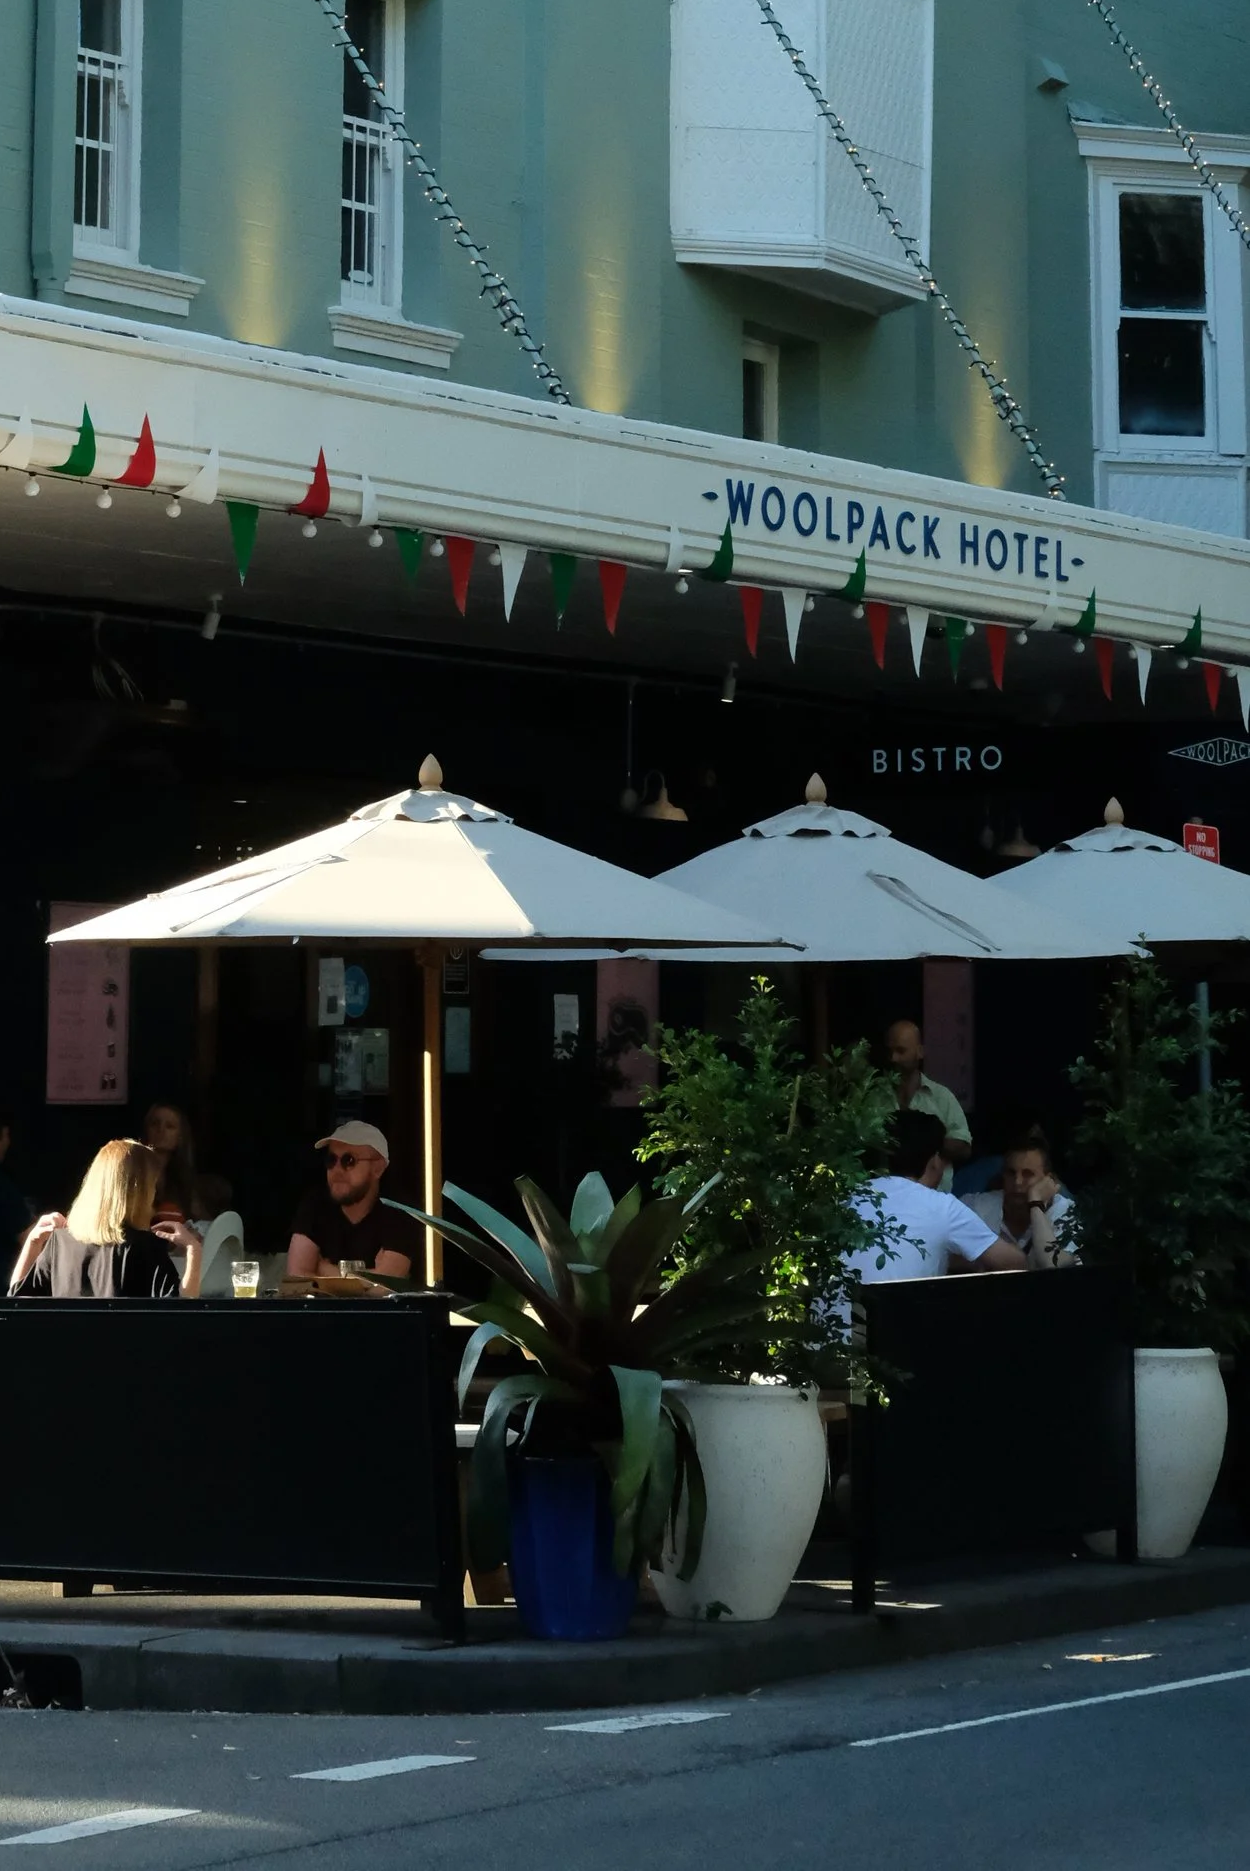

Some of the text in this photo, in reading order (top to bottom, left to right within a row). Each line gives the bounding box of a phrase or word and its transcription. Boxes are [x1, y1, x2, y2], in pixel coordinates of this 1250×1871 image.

[725, 478, 1069, 583] WOOLPACK HOTEL
[872, 745, 1003, 774] BISTRO
[1196, 832, 1207, 843] NO
[1188, 844, 1216, 858] STOPPING
